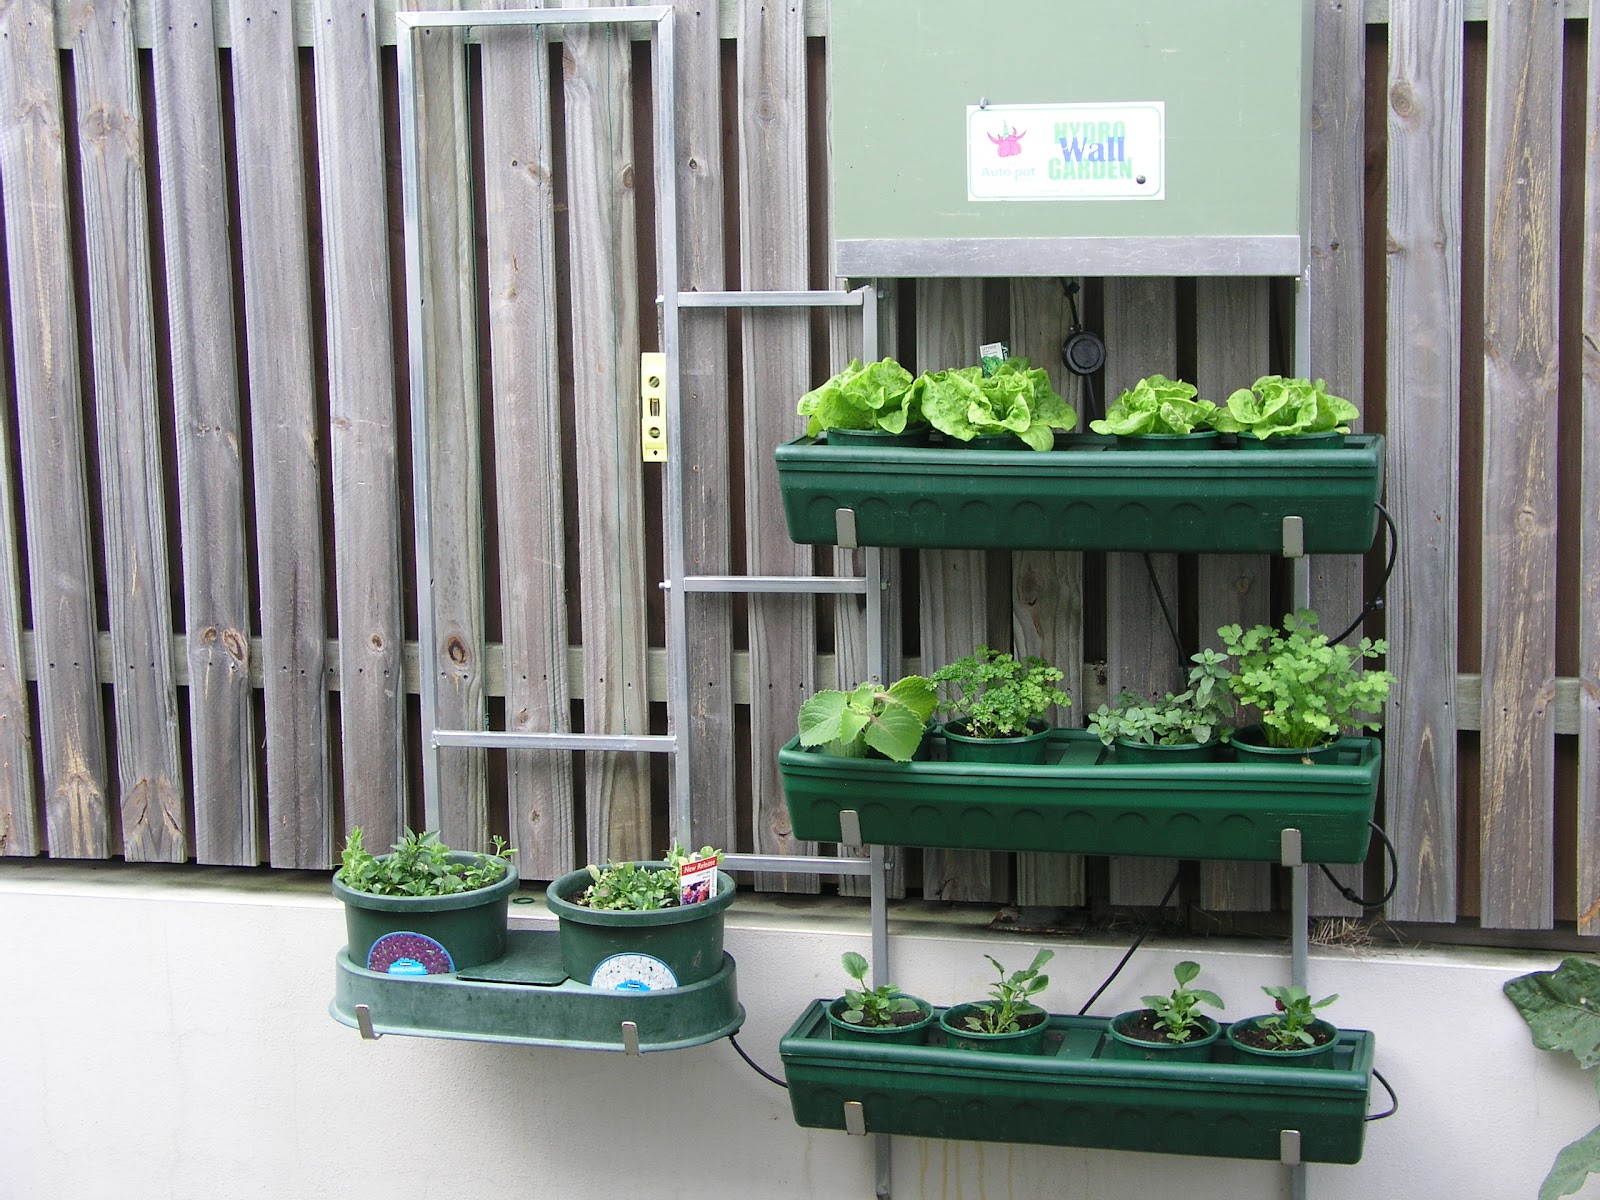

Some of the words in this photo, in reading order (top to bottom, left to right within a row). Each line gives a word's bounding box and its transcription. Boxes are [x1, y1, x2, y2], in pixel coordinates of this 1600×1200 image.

[1054, 120, 1126, 144] HYDRO
[1059, 136, 1125, 162] Wall
[981, 167, 1011, 177] Auto
[1014, 167, 1037, 181] pot
[1048, 157, 1133, 181] GARDEN
[684, 865, 697, 874] New
[697, 860, 716, 870] Release
